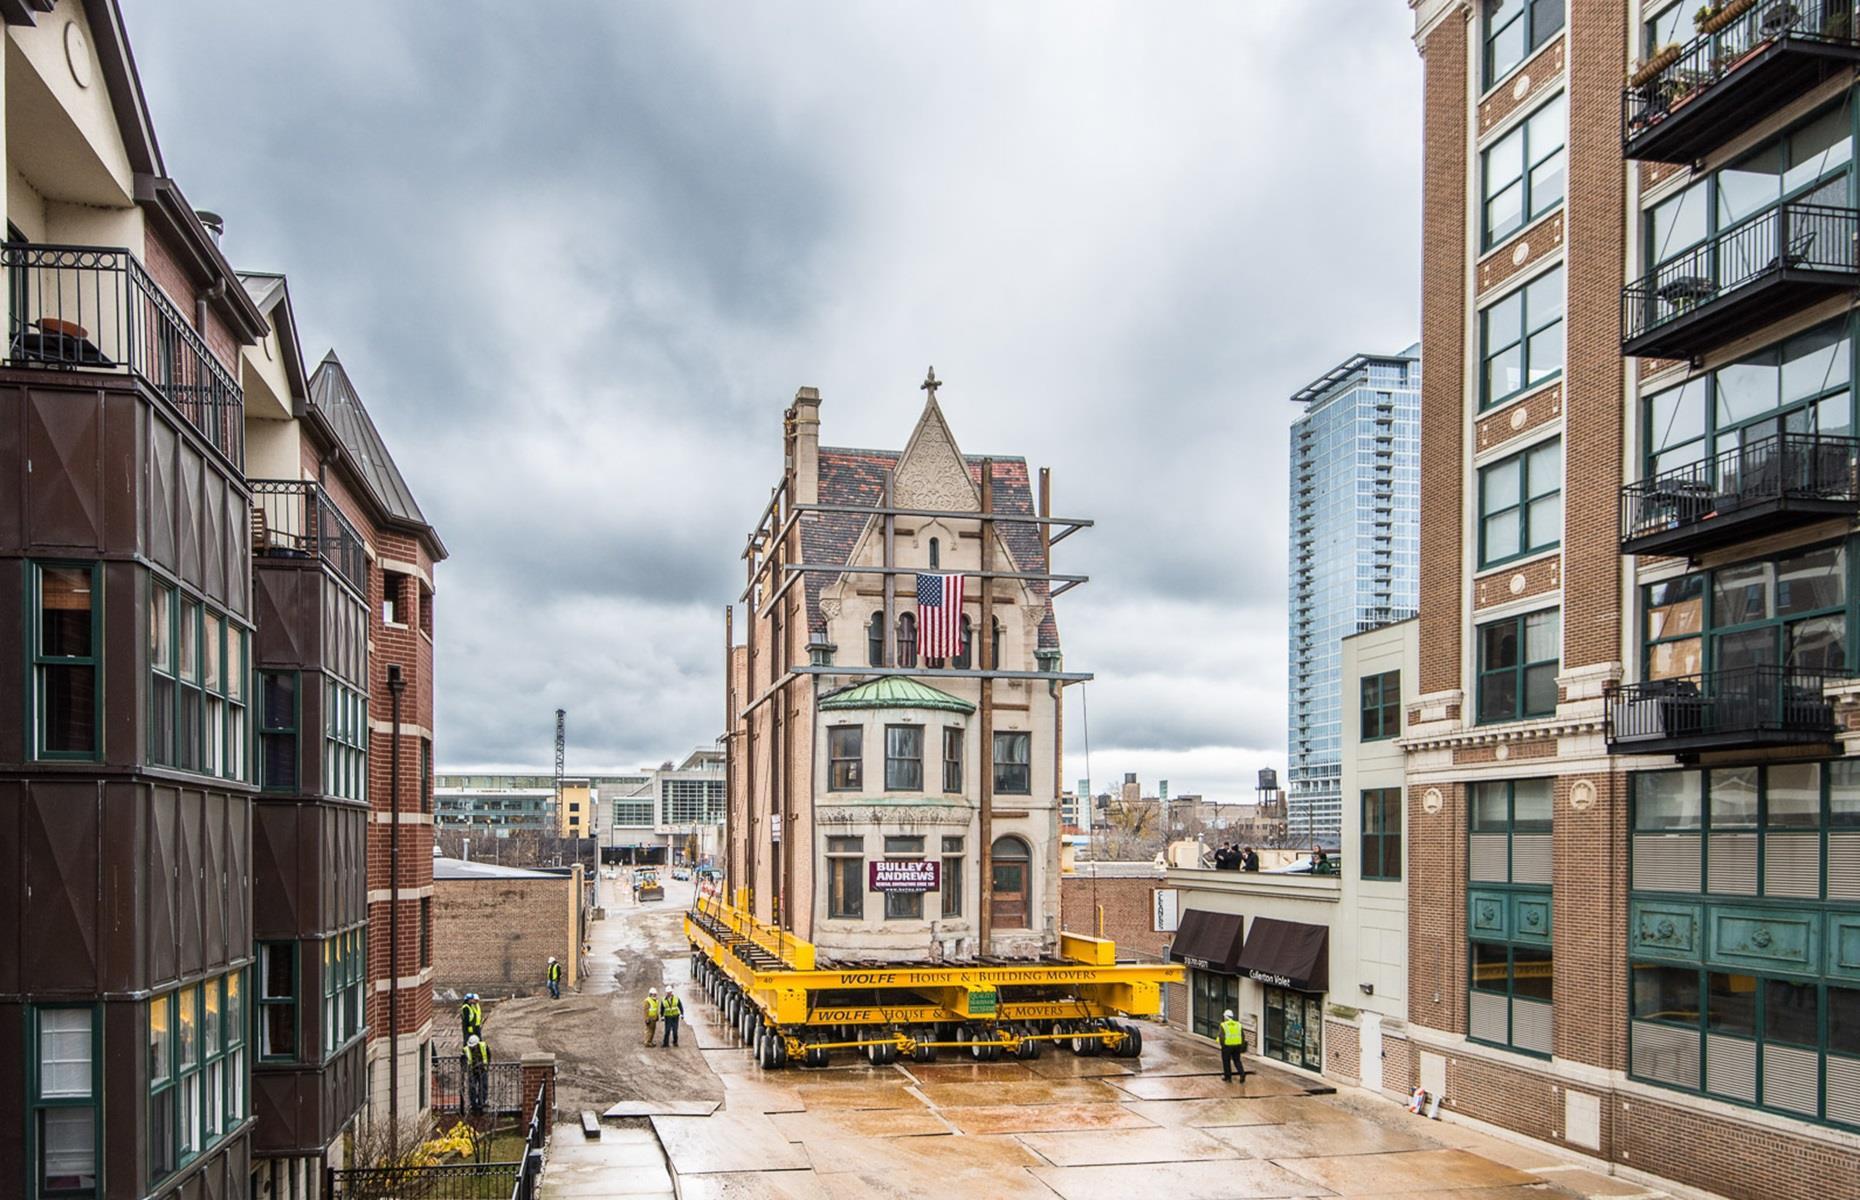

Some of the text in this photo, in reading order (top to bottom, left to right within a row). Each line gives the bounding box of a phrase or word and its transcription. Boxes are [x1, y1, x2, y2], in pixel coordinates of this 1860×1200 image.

[876, 862, 934, 871] BULLEY &
[876, 871, 934, 880] ANDREWS
[840, 970, 1097, 985] WOLFE HOUSE & BUILDING MOVERS
[818, 1008, 942, 1021] WOLFE HOUSE &
[1015, 1007, 1063, 1016] MOVERS
